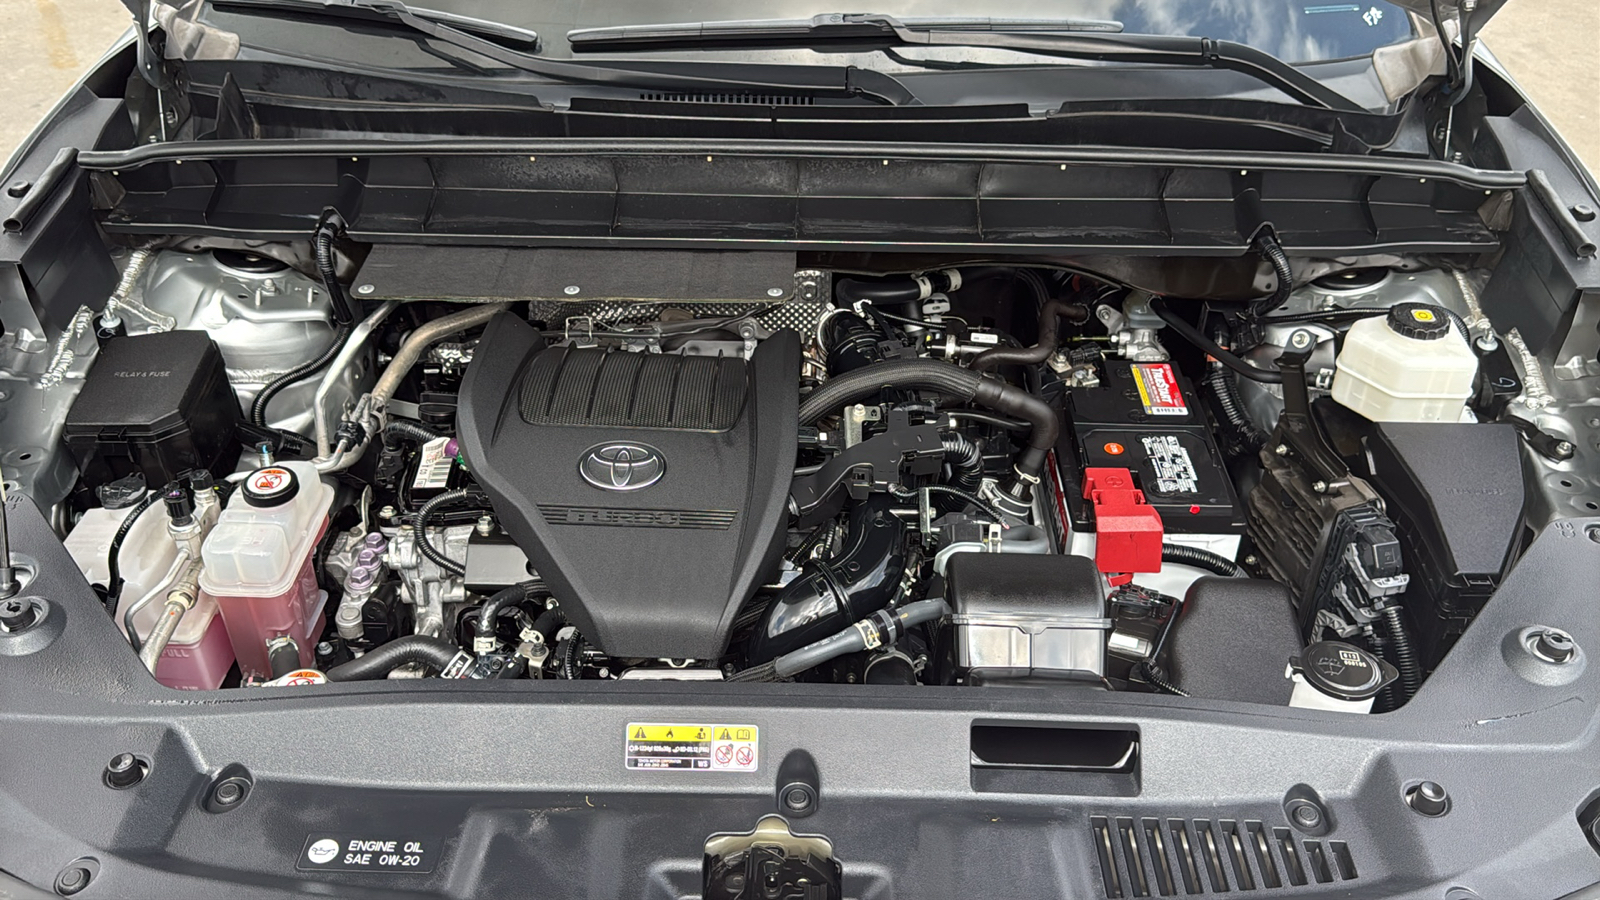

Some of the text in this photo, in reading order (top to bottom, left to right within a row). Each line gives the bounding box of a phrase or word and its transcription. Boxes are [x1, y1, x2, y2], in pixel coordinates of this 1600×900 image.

[348, 840, 424, 853] ENGINE OIL
[343, 854, 372, 865] SAE
